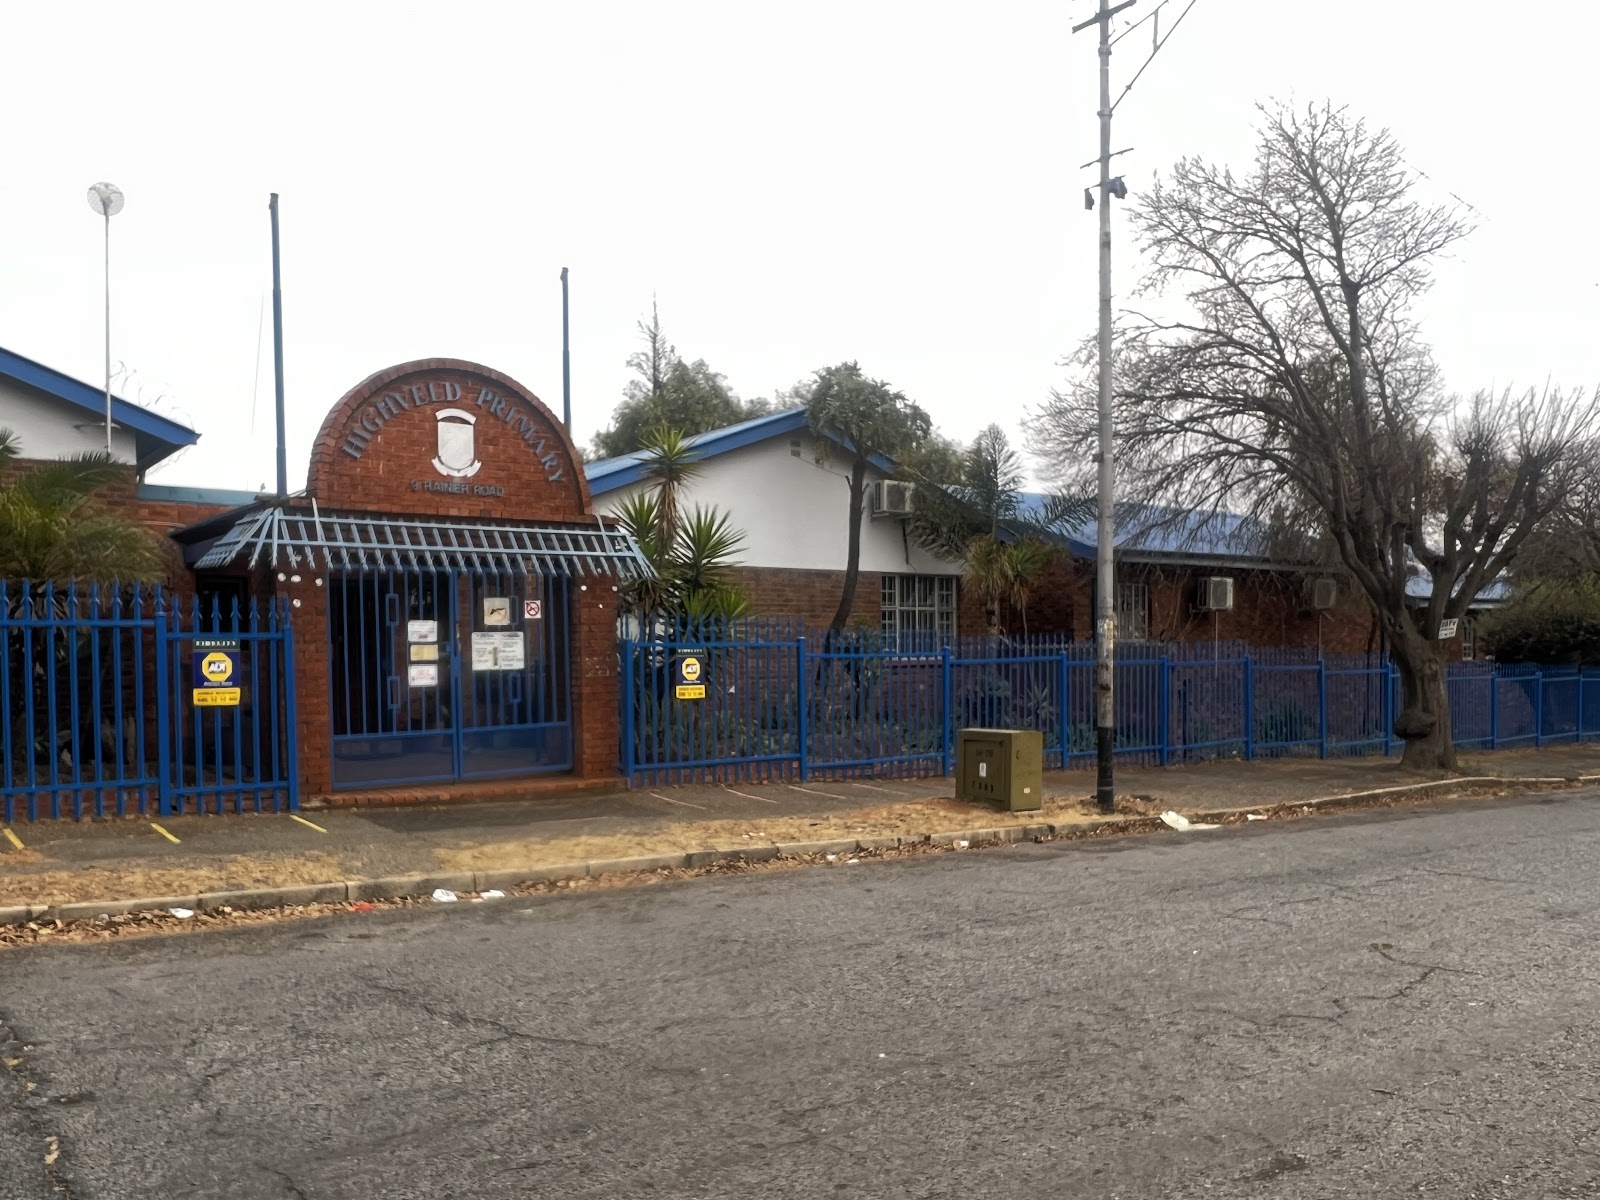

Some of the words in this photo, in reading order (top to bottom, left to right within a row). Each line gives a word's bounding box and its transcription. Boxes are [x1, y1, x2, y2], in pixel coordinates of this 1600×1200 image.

[342, 381, 462, 460] HIGHVELD
[476, 388, 565, 482] PRIMARY
[473, 484, 504, 497] ROAD
